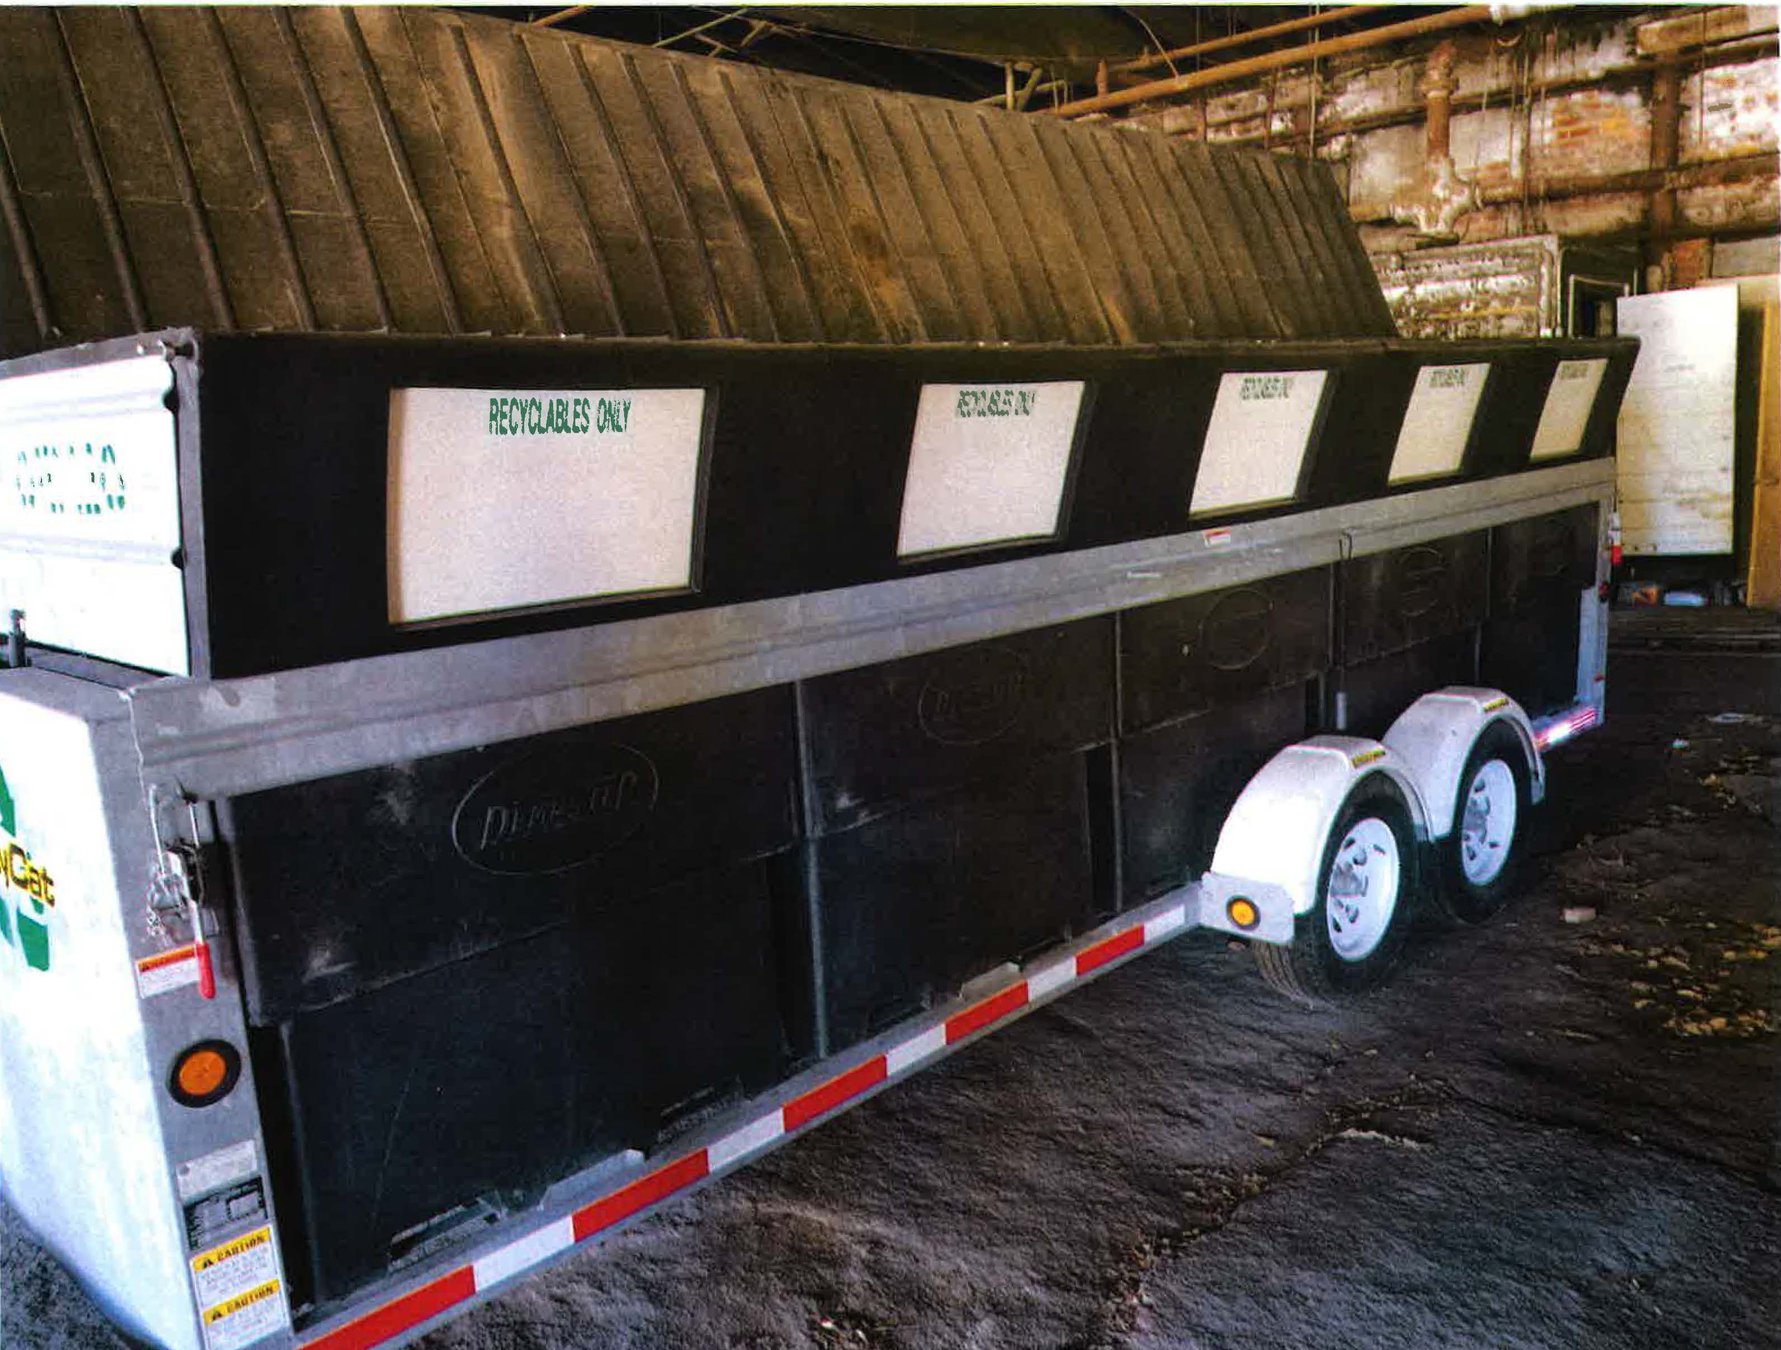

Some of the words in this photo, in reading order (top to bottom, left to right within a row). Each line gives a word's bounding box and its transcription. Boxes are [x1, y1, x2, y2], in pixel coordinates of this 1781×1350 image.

[489, 397, 591, 435] RECYCLABLES
[596, 397, 631, 433] ONLY
[217, 1234, 266, 1262] CAUTION
[227, 1285, 275, 1314] CAUTION
